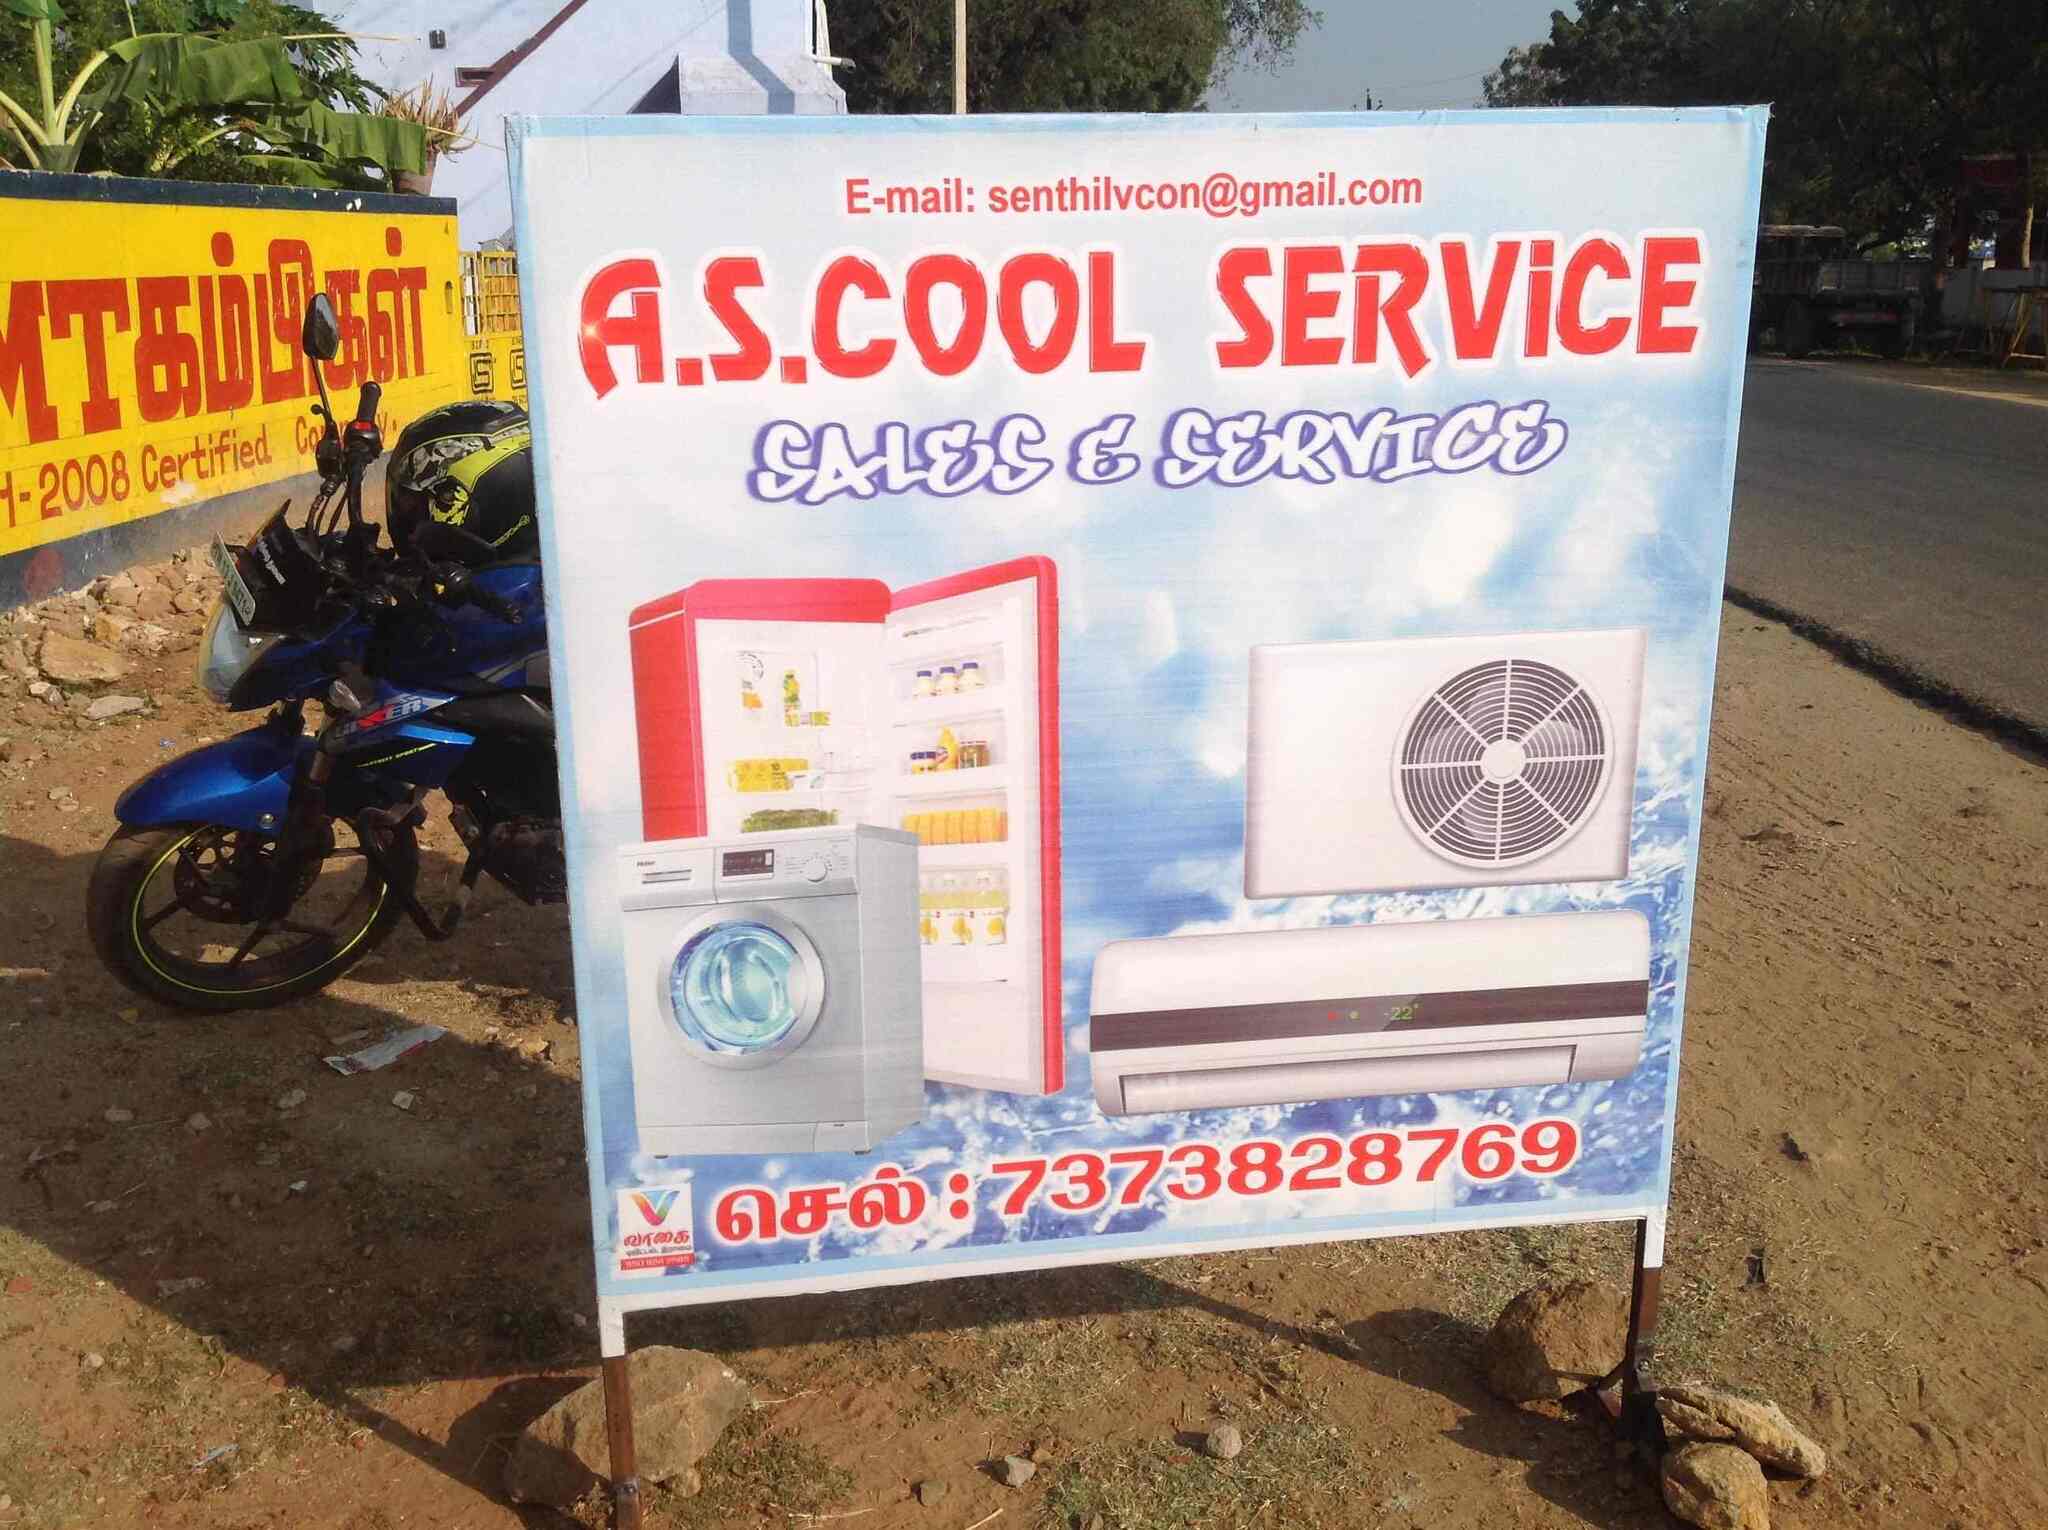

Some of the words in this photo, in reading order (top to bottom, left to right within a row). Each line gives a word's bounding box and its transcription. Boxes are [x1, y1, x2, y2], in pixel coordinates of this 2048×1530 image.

[847, 178, 974, 214] E-mail:
[988, 171, 1423, 218] senthilvcon@gmail.com
[579, 250, 1147, 400] A.S.COOL
[1215, 237, 1701, 378] SERVICE
[140, 422, 273, 493] Certified
[747, 413, 1055, 505] SALES
[1153, 399, 1568, 488] SERVICE
[715, 1166, 926, 1242] செல்
[990, 1119, 1578, 1216] 7373828769
